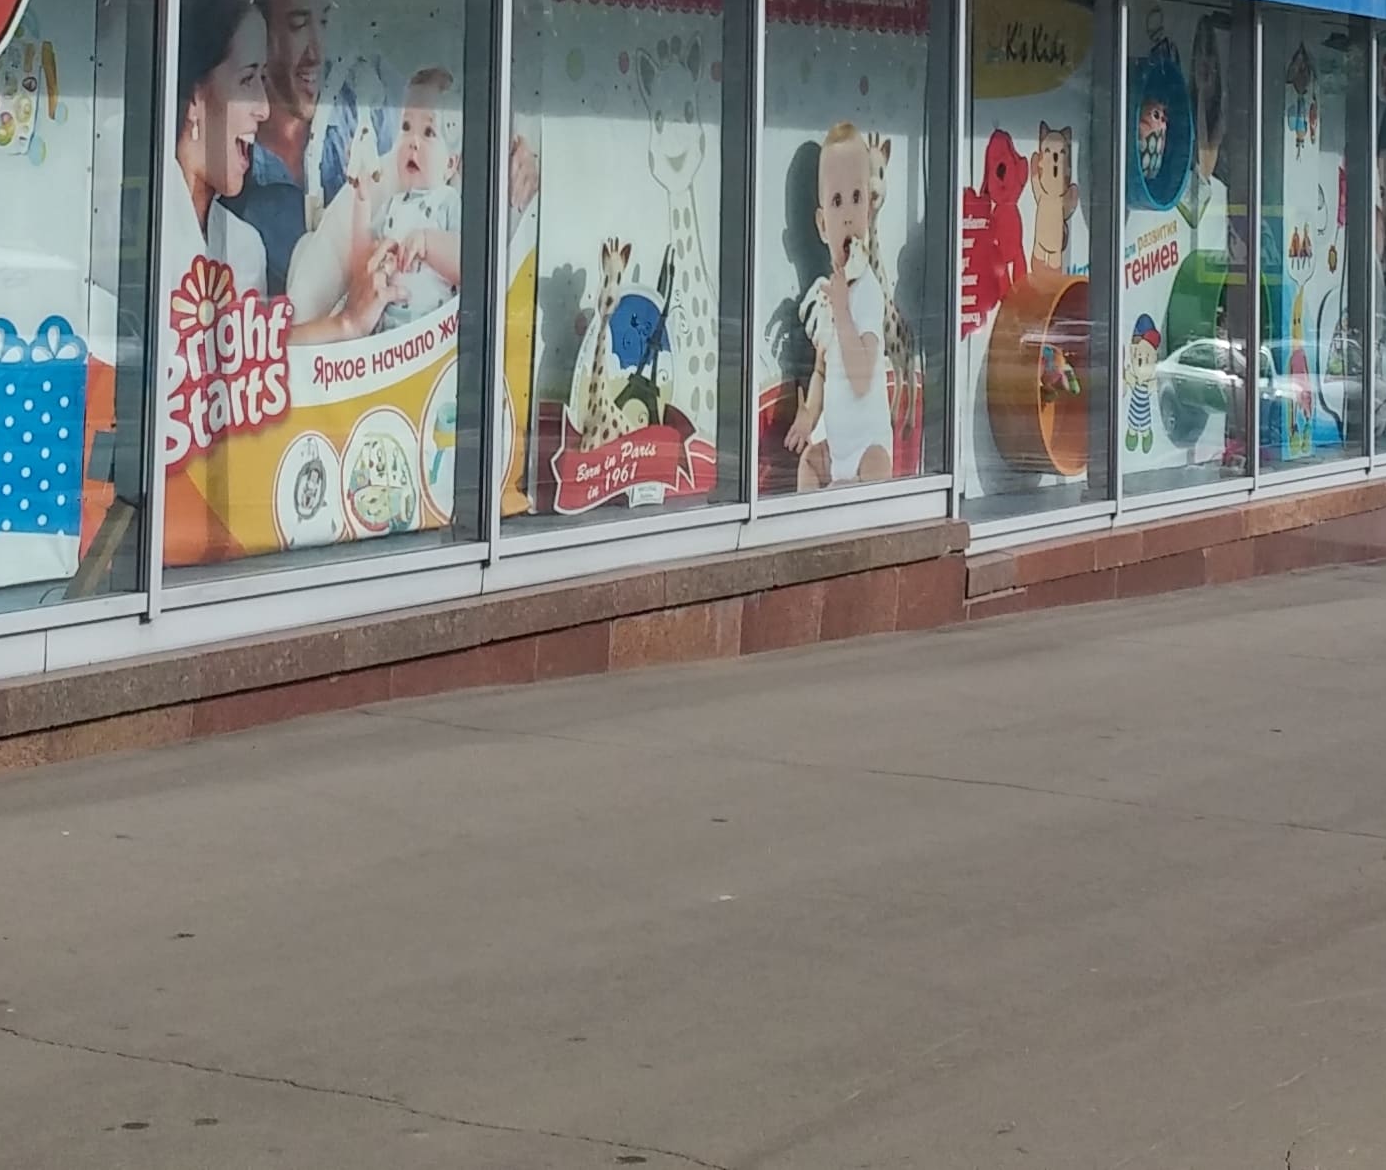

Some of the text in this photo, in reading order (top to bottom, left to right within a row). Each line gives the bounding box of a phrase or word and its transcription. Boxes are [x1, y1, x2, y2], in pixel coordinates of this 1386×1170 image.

[1124, 241, 1179, 290] гениев
[313, 355, 366, 392] Яркое
[372, 328, 435, 375] начало
[165, 363, 287, 466] Starts
[576, 441, 657, 482] Born in Paris
[587, 461, 638, 501] in 1961
